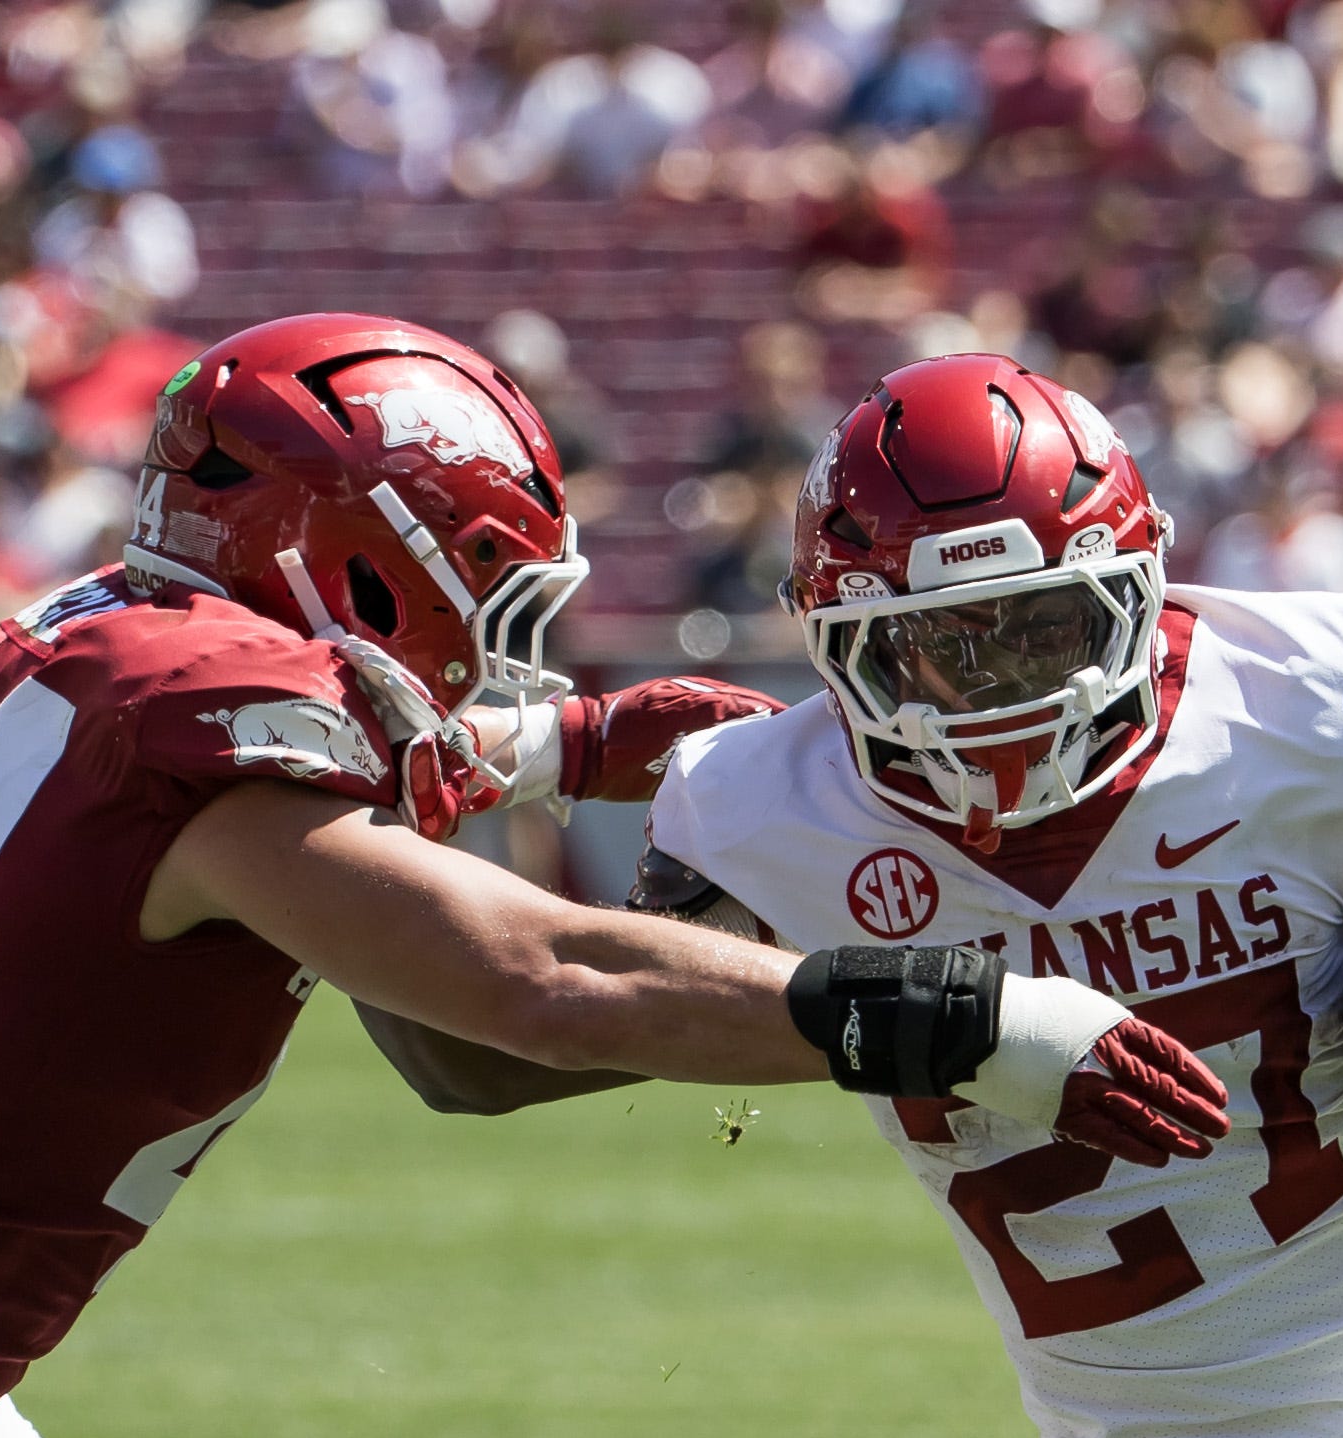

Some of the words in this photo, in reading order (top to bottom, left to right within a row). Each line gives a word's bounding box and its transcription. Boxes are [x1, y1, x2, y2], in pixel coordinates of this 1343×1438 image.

[938, 535, 1007, 566] HOGS
[1068, 539, 1113, 562] OAKLEY
[839, 589, 885, 598] OAKLEY
[854, 855, 932, 934] SEC
[953, 872, 1292, 997] ANSAS
[843, 1006, 862, 1070] DONJOY
